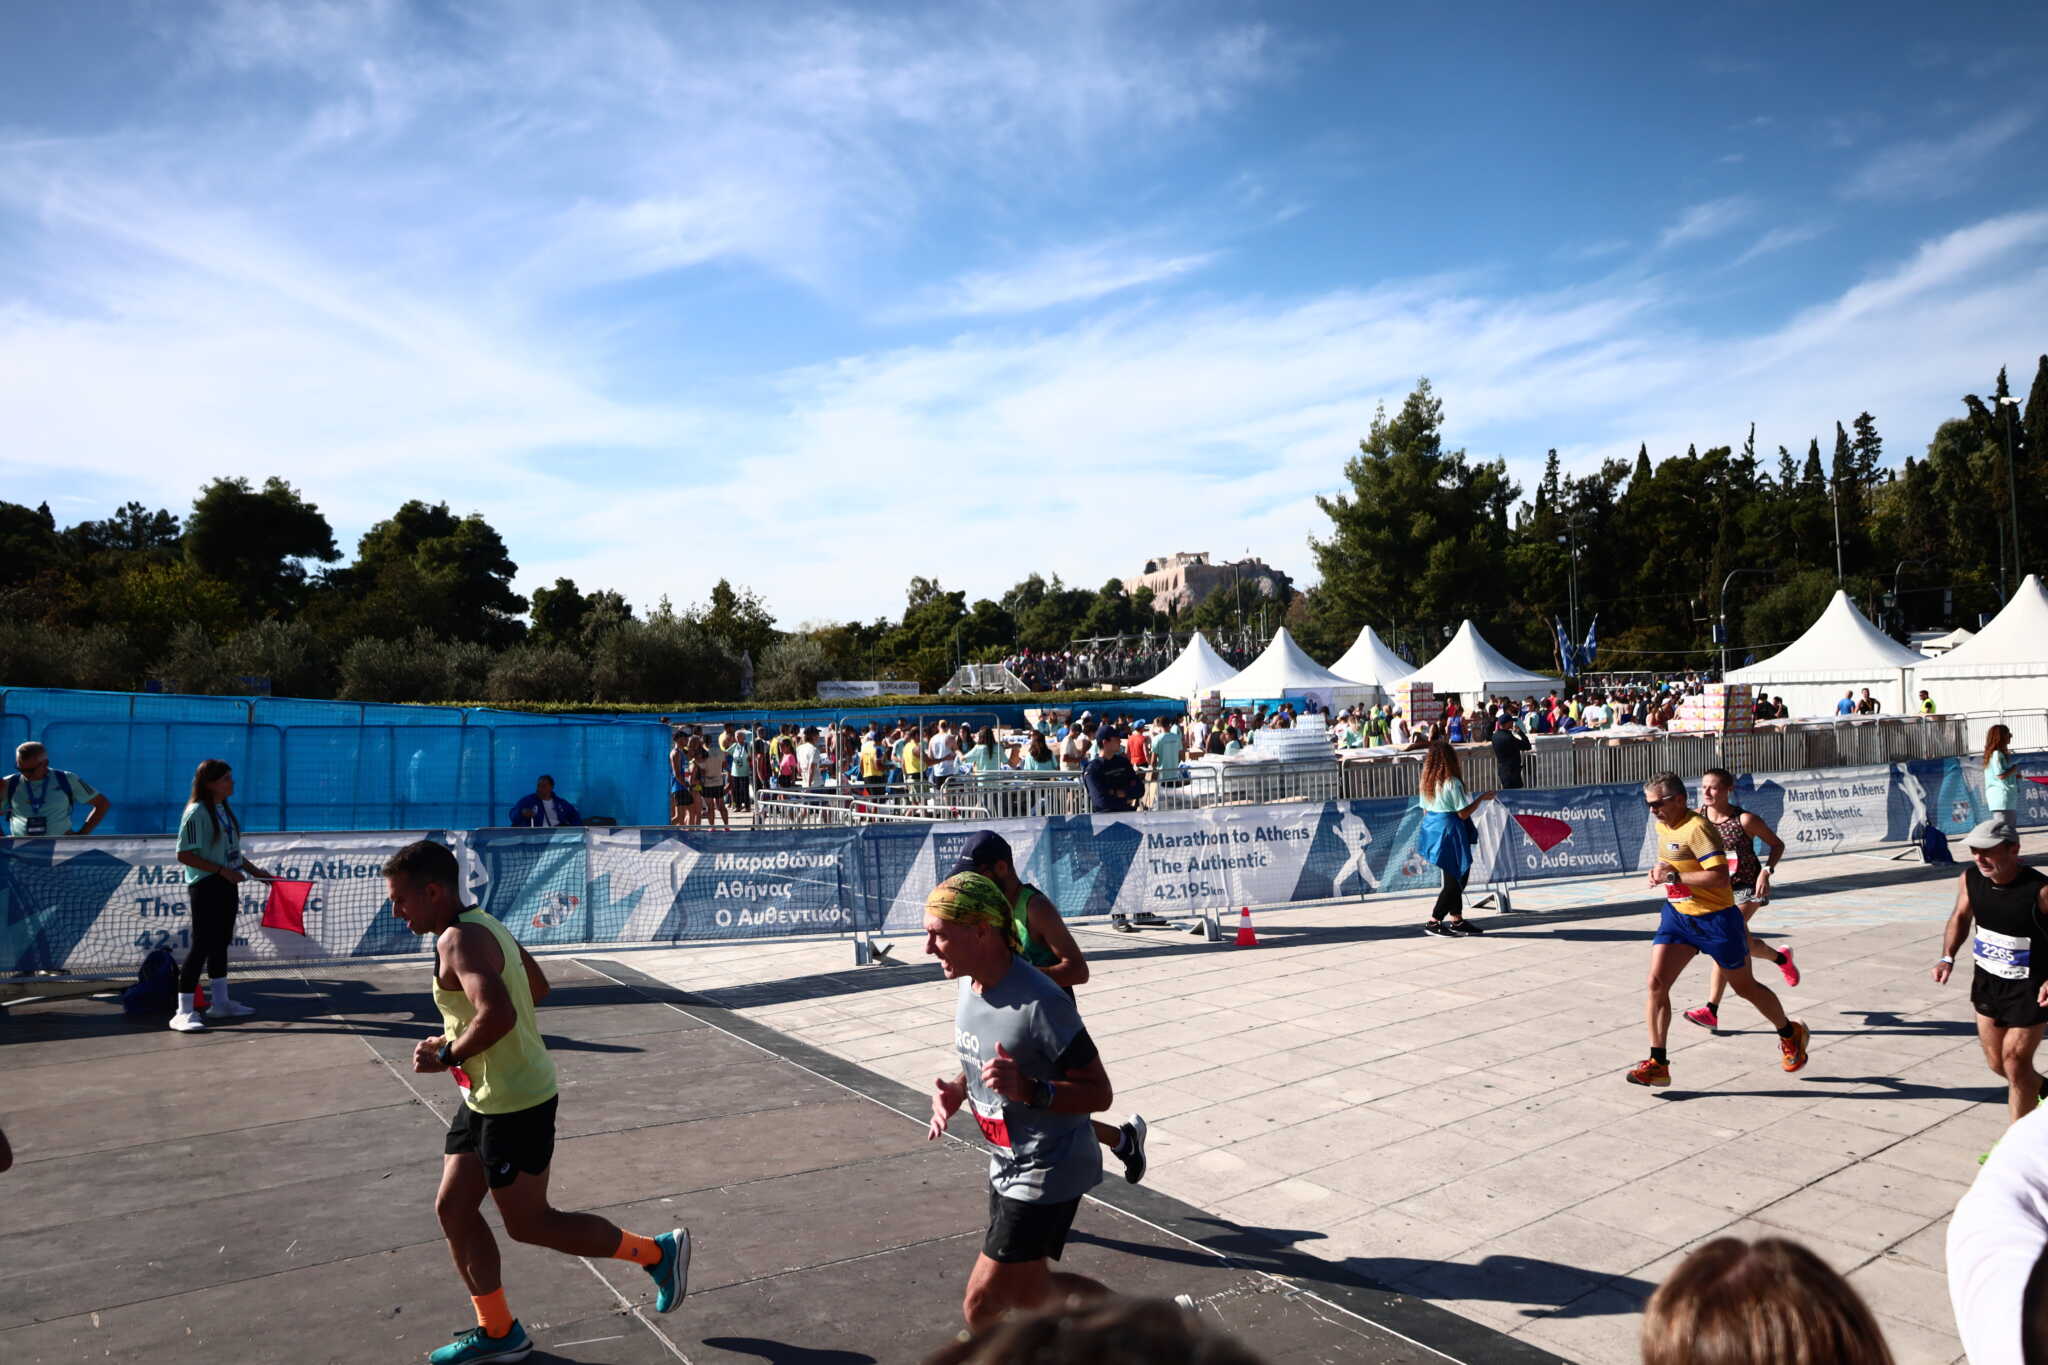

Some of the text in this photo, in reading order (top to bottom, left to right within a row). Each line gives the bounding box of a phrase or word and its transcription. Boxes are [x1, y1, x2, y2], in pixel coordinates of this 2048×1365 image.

[1788, 783, 1886, 802] Marathon to Athens
[1793, 805, 1863, 822] The Authentic
[1148, 825, 1310, 849] Marathon to Athens
[714, 851, 844, 874] Μαραθώνιος
[1149, 852, 1268, 875] The Authentic
[1541, 849, 1618, 868] Αυθεντικός
[275, 859, 382, 880] to Athen
[714, 880, 793, 901] Αθήνας
[1154, 881, 1226, 900] 42.195km
[136, 897, 187, 917] The
[737, 904, 851, 927] Αυθεντικός
[1982, 943, 2016, 962] 2265
